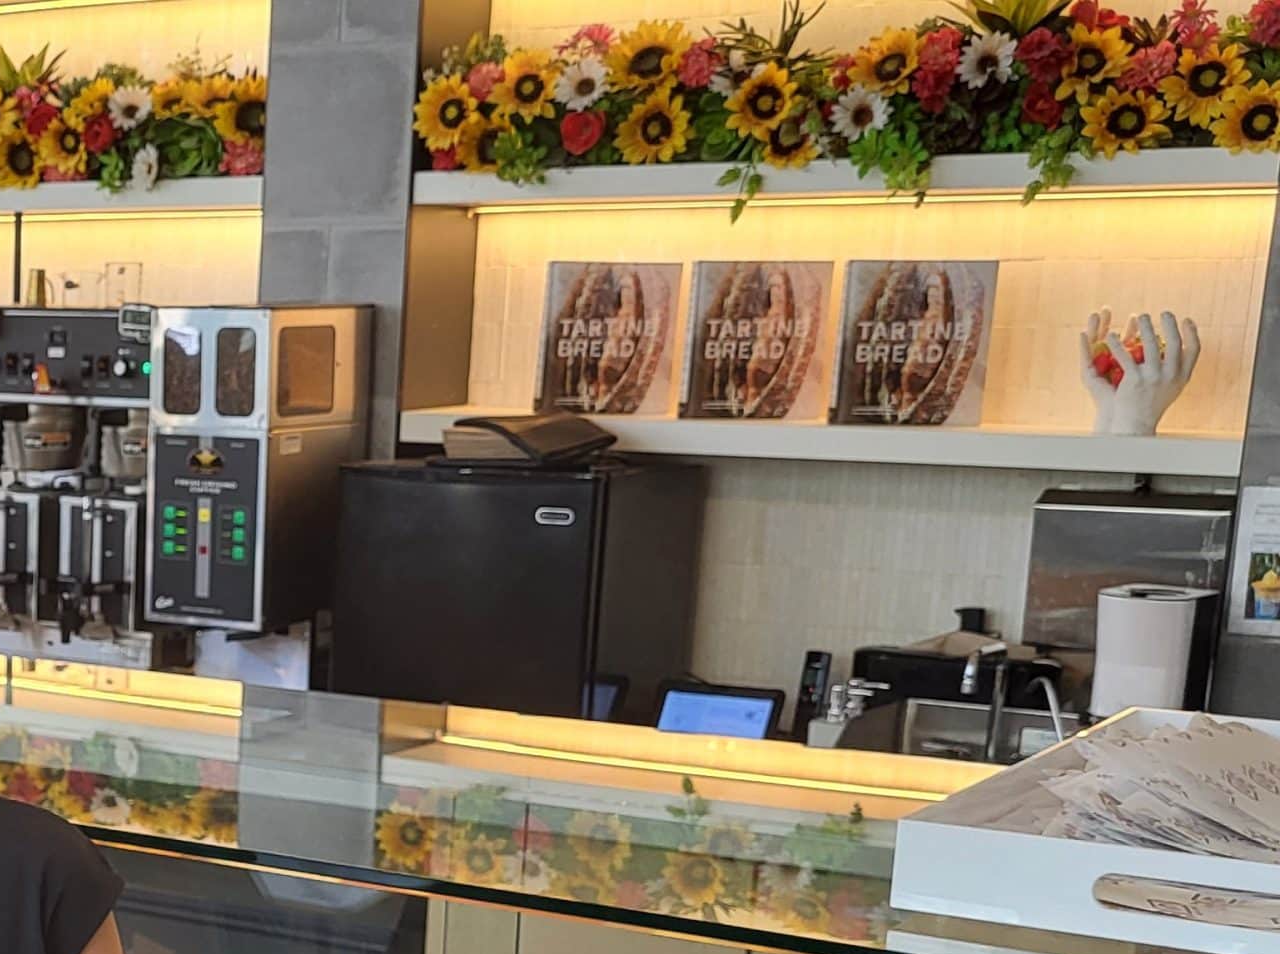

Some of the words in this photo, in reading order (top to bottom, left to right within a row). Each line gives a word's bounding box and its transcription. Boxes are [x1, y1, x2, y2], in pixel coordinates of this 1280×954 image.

[559, 317, 659, 338] TARTINE
[706, 317, 807, 338] TARTINE
[857, 320, 966, 341] TARTINE
[557, 338, 636, 359] BREAD
[704, 339, 786, 360] BREAD
[855, 342, 944, 364] BREAD
